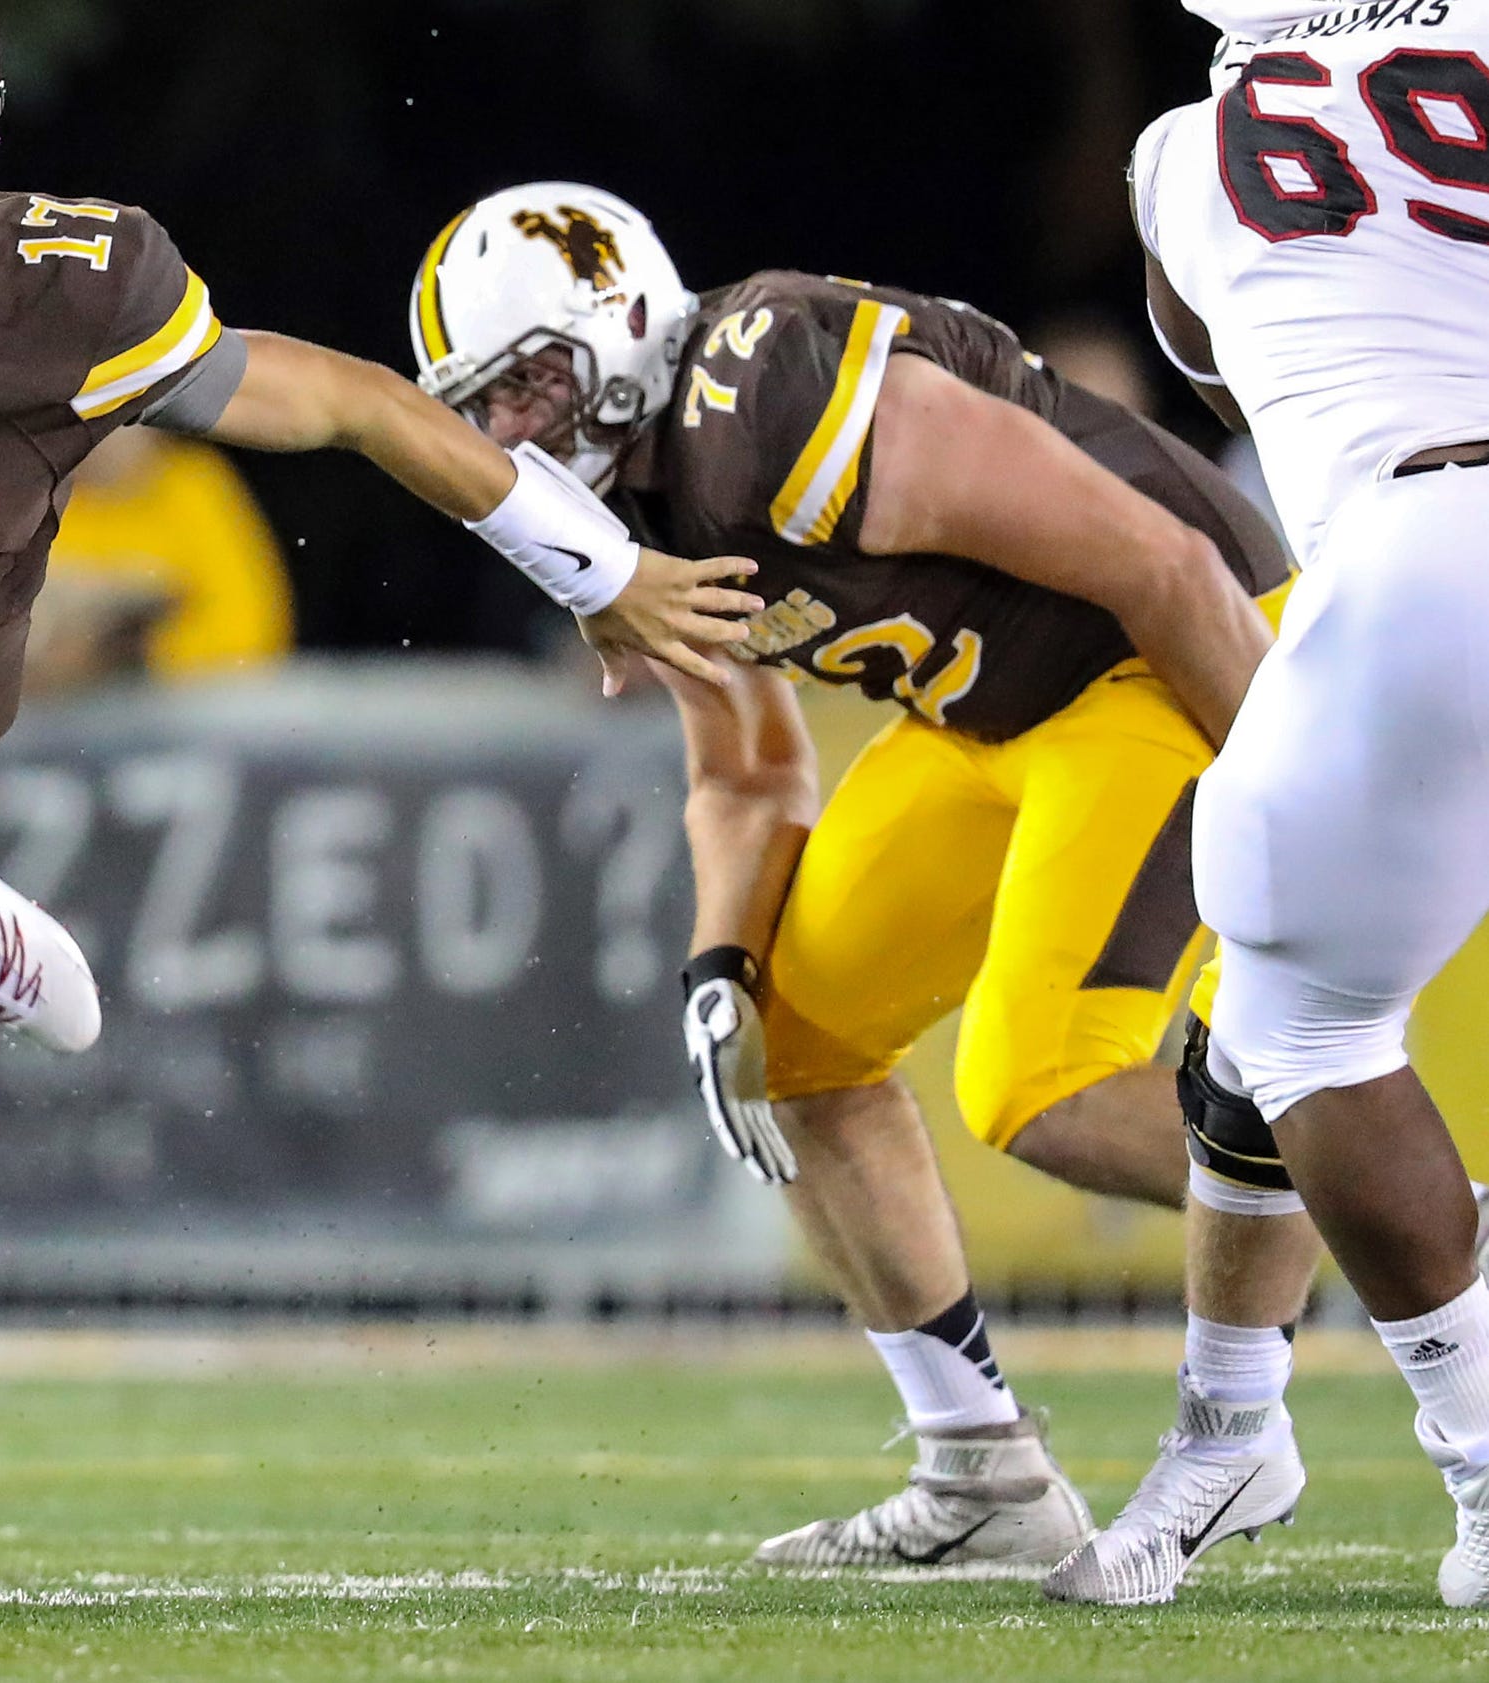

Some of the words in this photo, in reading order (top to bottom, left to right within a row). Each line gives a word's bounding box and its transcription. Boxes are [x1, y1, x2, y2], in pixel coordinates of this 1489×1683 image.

[1216, 47, 1489, 246] 69
[17, 195, 119, 272] 17
[683, 307, 773, 428] 72
[778, 612, 984, 726] 2
[1409, 1342, 1460, 1362] adidas
[1224, 1407, 1269, 1437] NIKE
